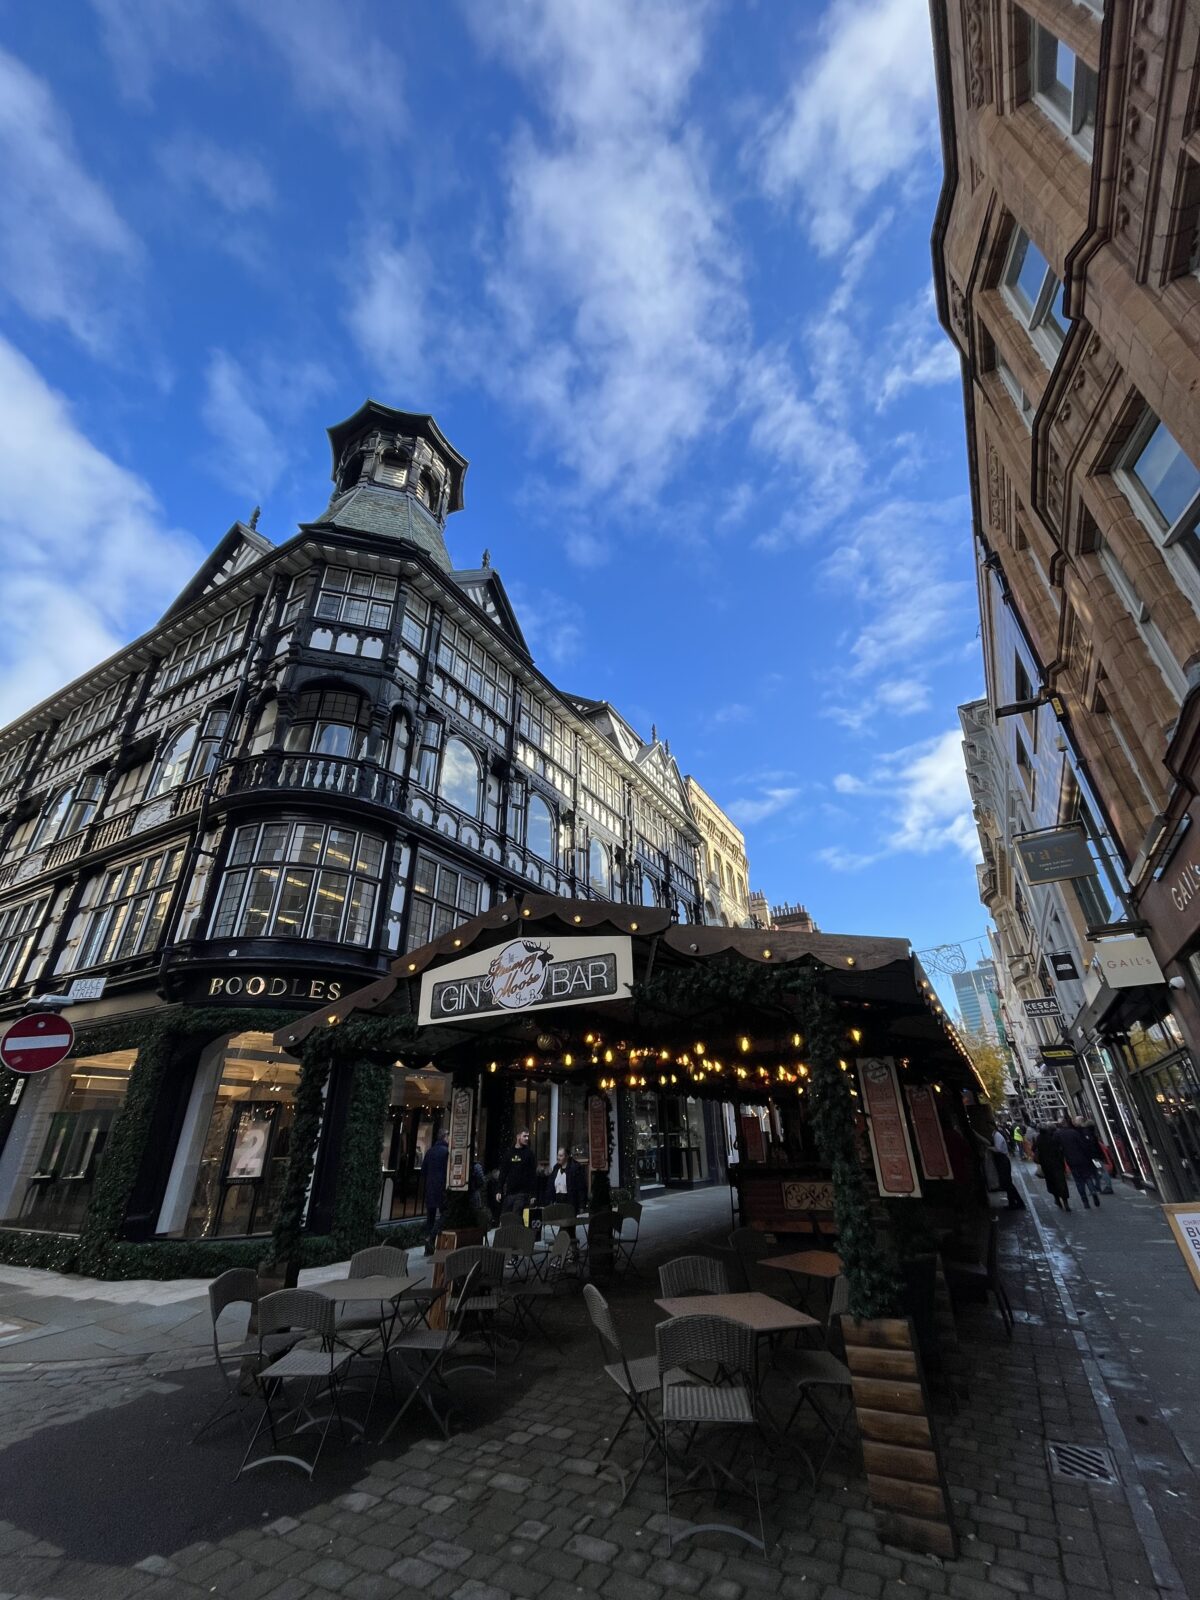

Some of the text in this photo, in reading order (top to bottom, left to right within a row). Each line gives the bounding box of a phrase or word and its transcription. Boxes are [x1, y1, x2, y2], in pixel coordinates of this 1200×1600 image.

[208, 976, 341, 1001] BOODLES
[440, 961, 607, 1012] GIN BAR
[483, 952, 539, 991] Grumpy
[492, 969, 541, 1003] Moose
[1025, 1001, 1057, 1010] KESEA
